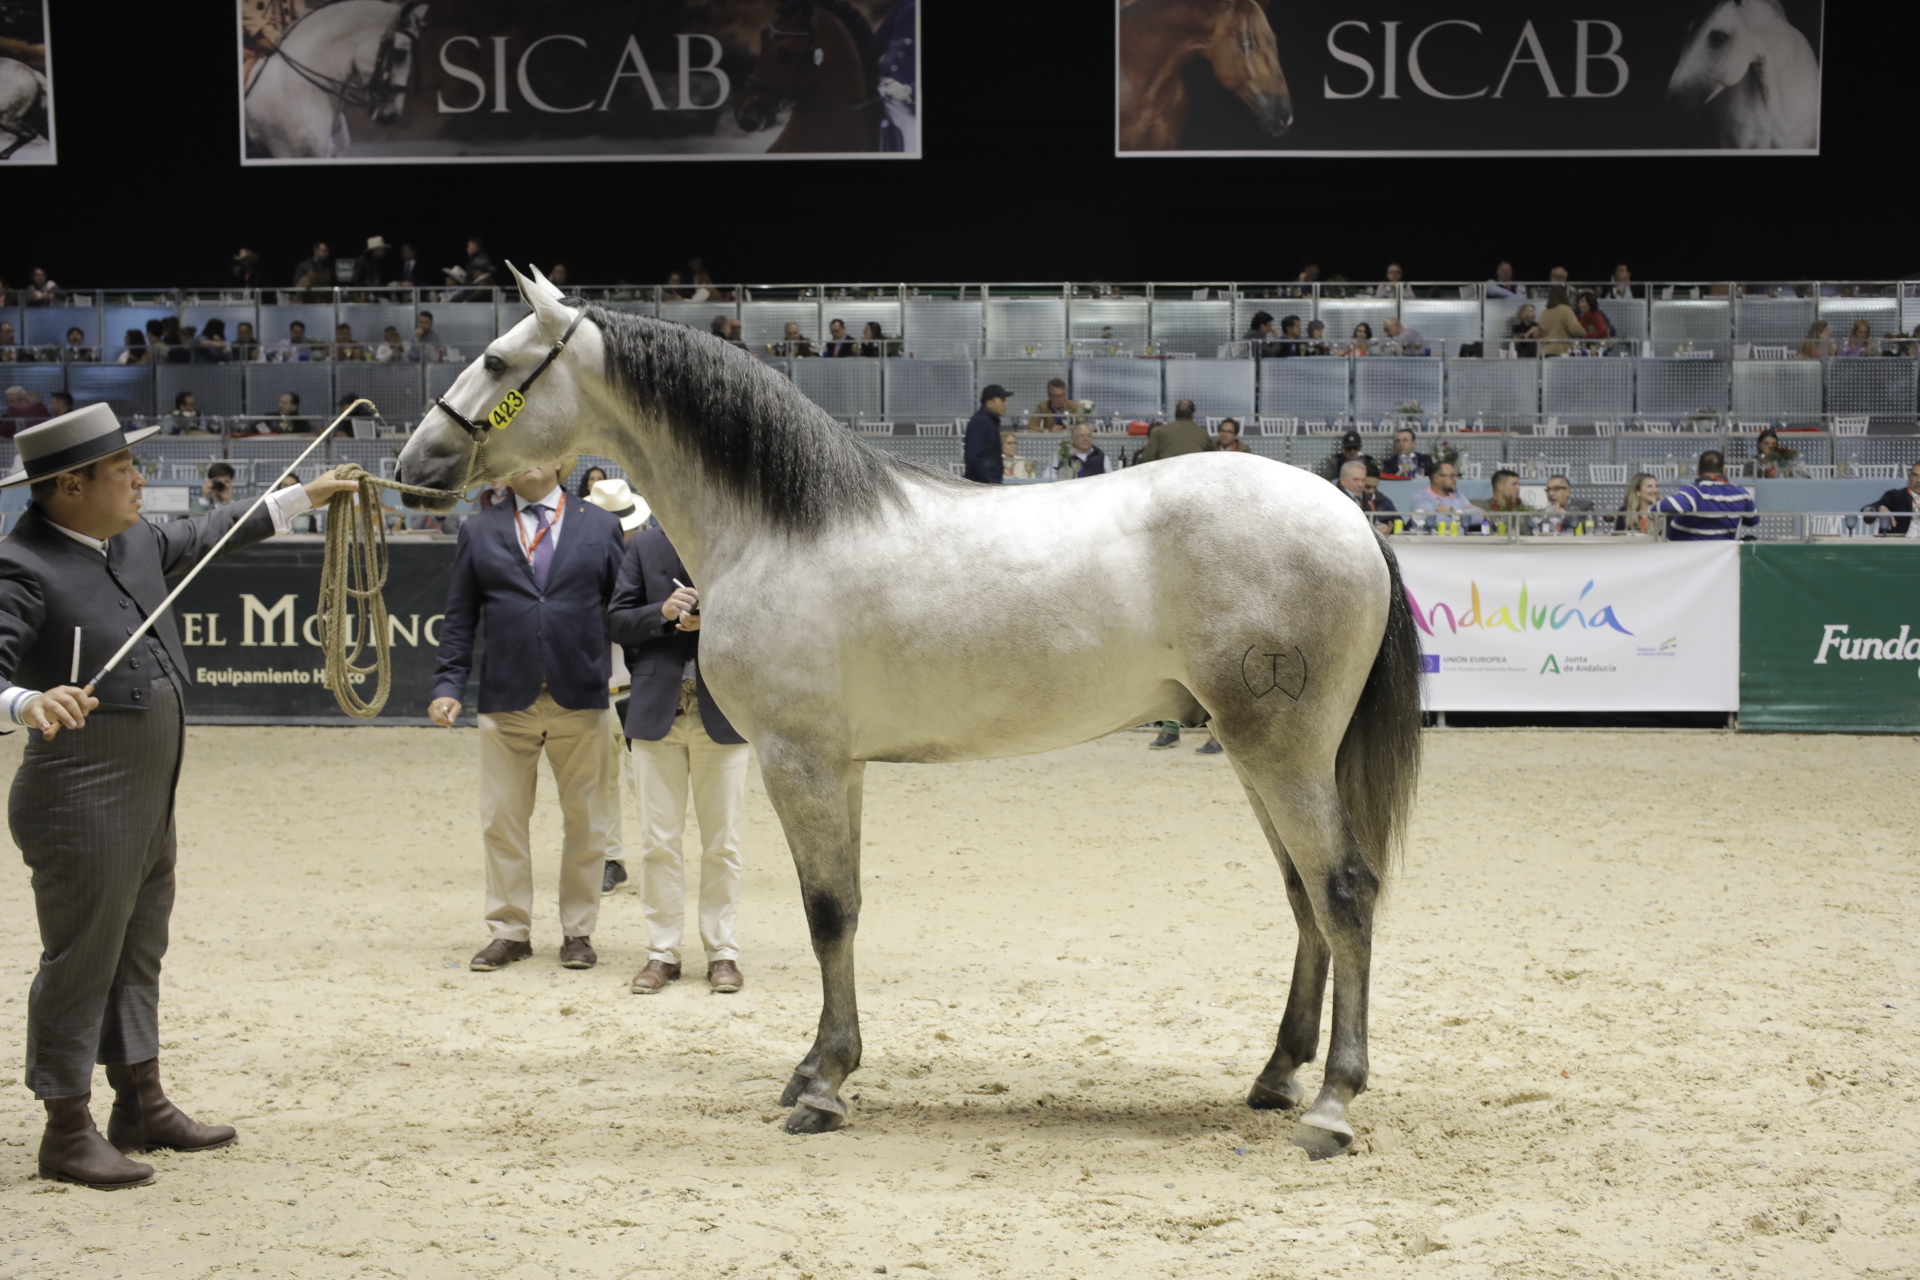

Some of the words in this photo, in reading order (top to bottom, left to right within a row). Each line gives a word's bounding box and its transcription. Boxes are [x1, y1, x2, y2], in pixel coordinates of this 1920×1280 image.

[437, 33, 731, 115] SICAB
[1323, 19, 1629, 100] SICAB
[493, 391, 523, 426] 423
[182, 612, 227, 646] EL
[1563, 655, 1588, 663] Junta
[1563, 664, 1574, 672] de
[1575, 663, 1617, 672] Andalucía
[197, 667, 310, 687] Equipamiento
